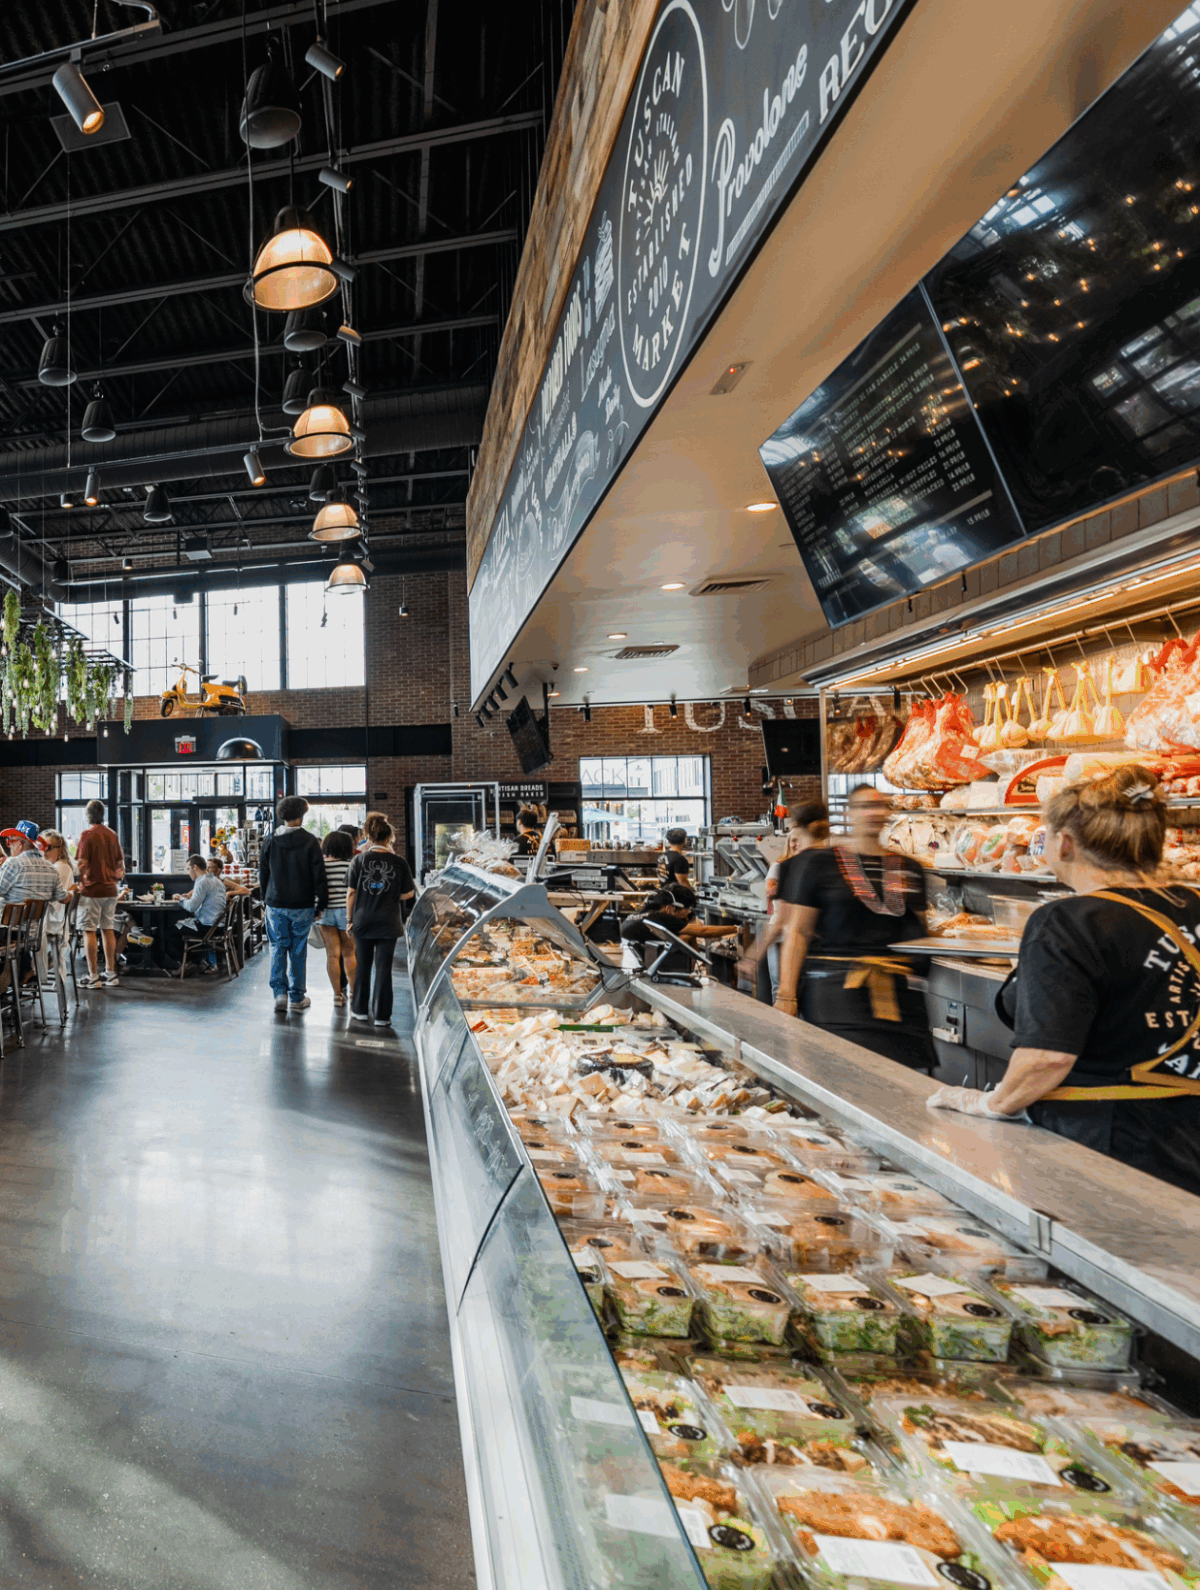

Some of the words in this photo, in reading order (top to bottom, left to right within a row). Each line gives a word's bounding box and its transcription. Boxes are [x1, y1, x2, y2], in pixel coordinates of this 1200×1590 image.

[628, 51, 685, 212] TUSCAN
[708, 43, 808, 277] Provolone
[628, 153, 693, 315] ESTABLISHED
[648, 255, 669, 317] 2010
[564, 280, 582, 376] FOODS
[580, 302, 616, 402] Lasagna
[632, 222, 691, 372] MARKET
[520, 784, 544, 792] BREADS
